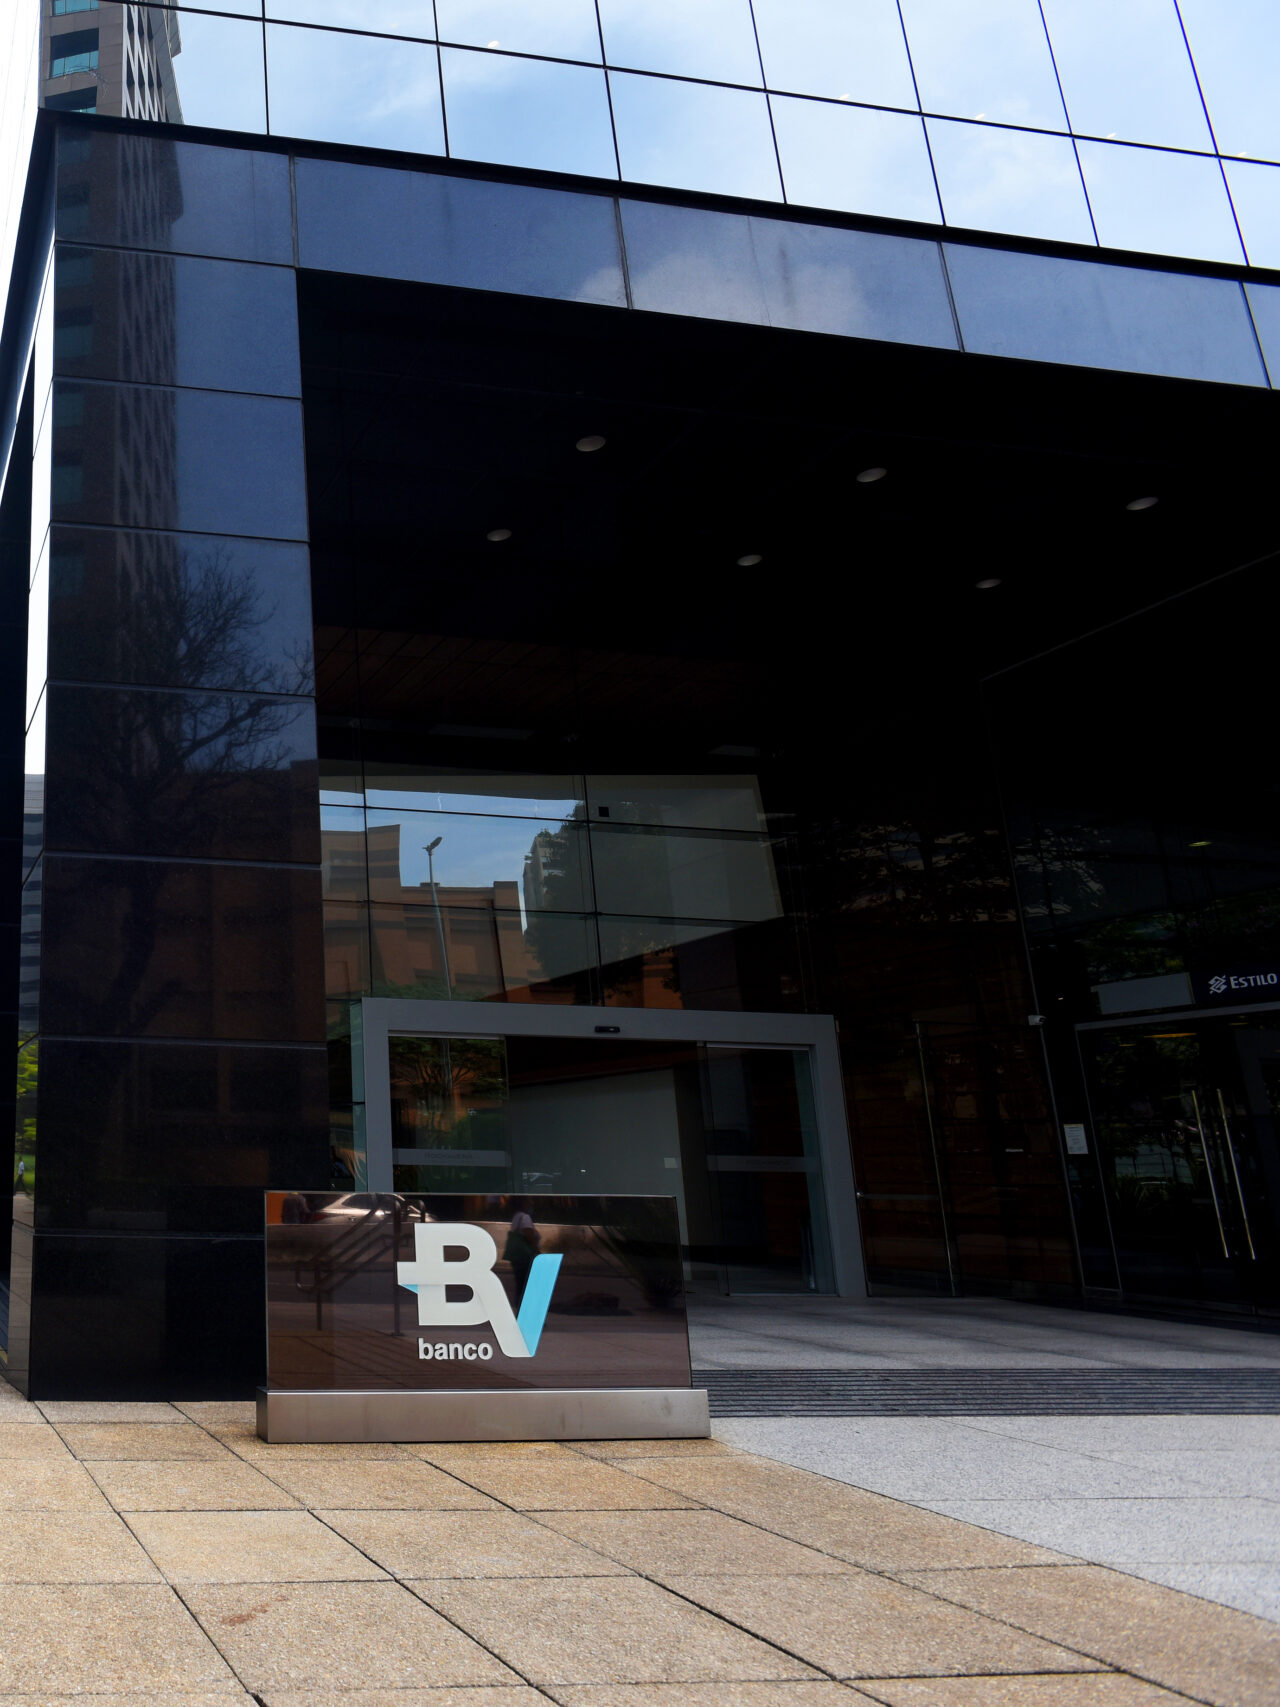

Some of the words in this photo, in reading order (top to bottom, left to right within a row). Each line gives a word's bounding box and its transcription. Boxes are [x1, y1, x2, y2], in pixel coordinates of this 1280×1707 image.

[1229, 972, 1278, 989] ESTILO
[397, 1222, 564, 1358] BV
[417, 1337, 493, 1361] banco
